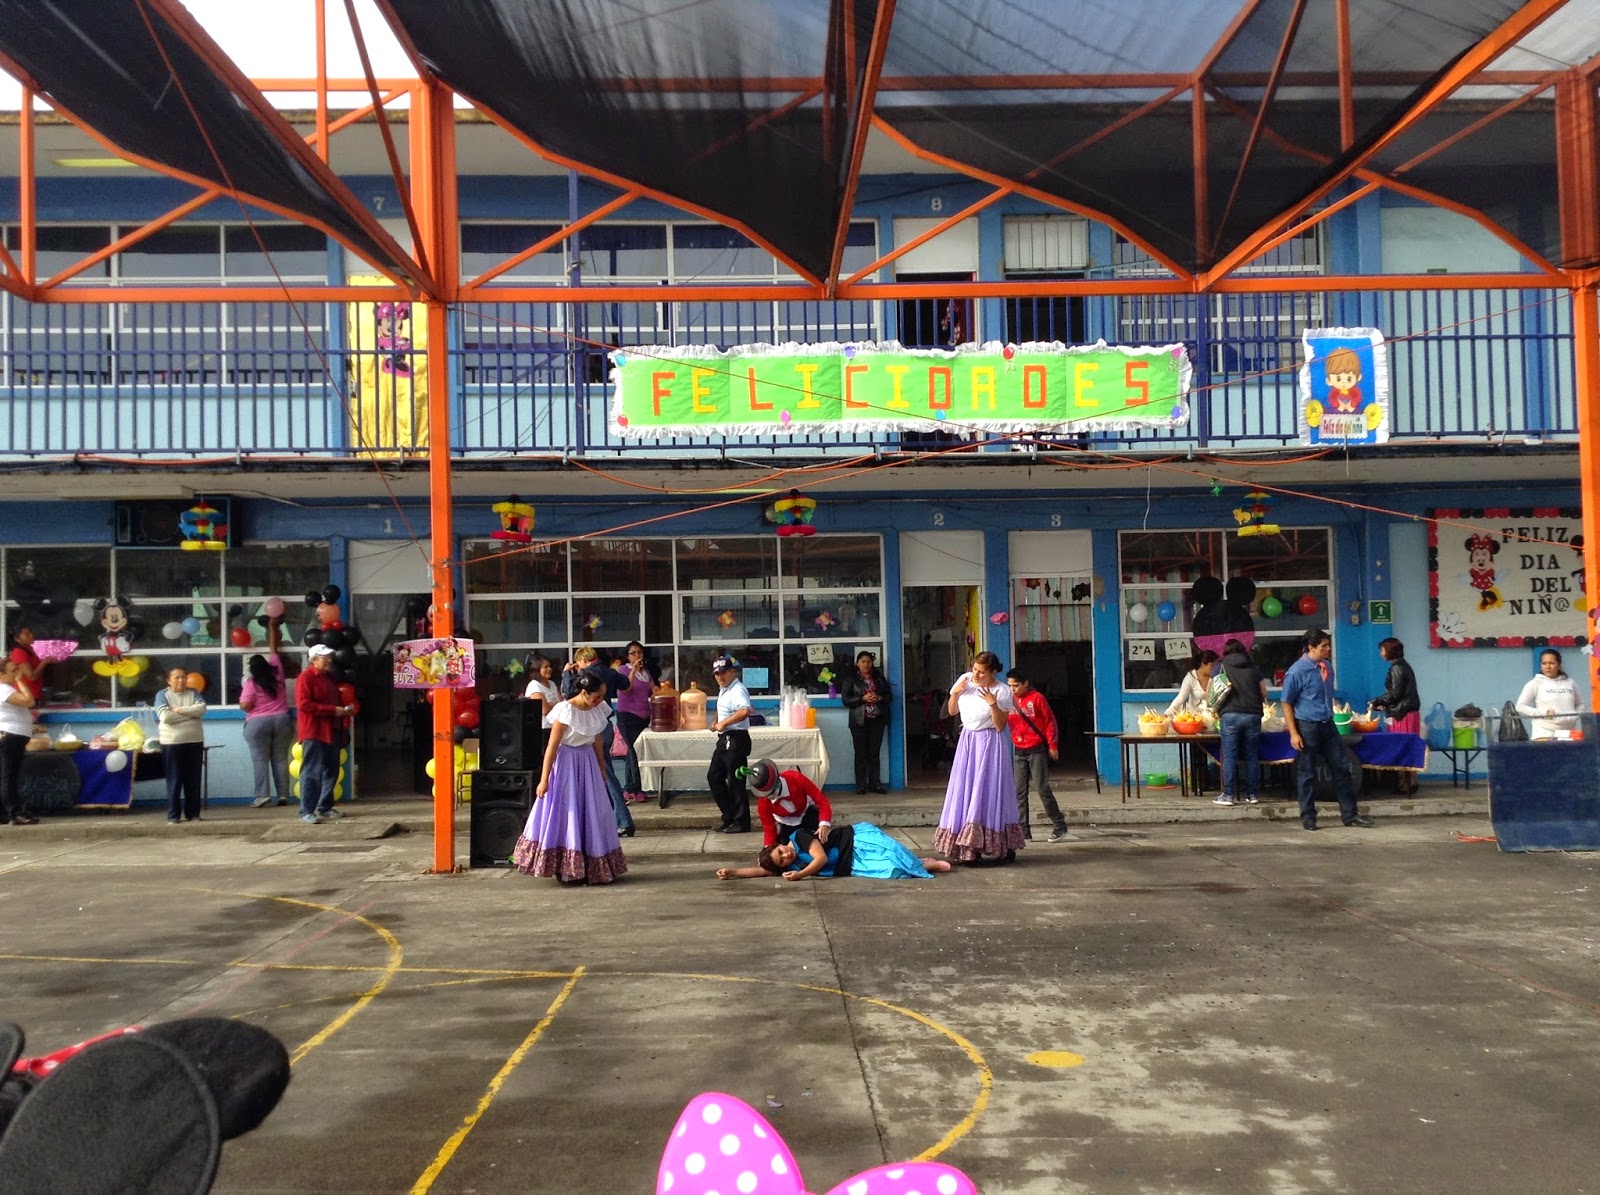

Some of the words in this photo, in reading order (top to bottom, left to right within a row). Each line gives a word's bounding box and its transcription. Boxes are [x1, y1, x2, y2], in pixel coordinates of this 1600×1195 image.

[373, 196, 385, 211] 7
[931, 198, 942, 211] 8
[652, 361, 1149, 416] FELICIDADES
[384, 518, 393, 533] 1
[933, 513, 945, 526] 2
[1051, 514, 1062, 527] 3
[1502, 527, 1569, 543] FELIZ
[1520, 554, 1561, 570] DIA
[1530, 577, 1572, 593] DEL
[1508, 594, 1570, 615] NIÑ@
